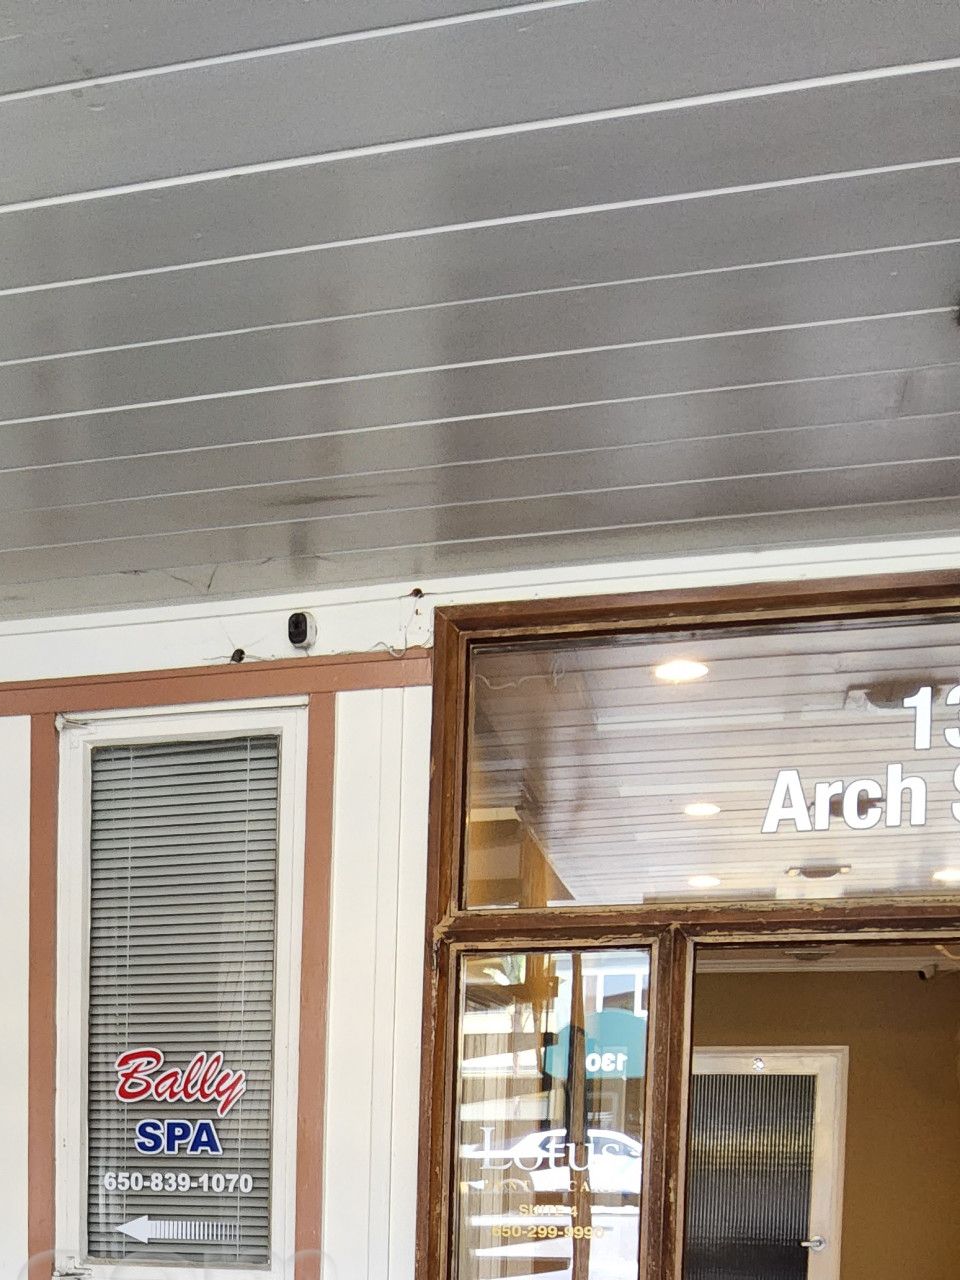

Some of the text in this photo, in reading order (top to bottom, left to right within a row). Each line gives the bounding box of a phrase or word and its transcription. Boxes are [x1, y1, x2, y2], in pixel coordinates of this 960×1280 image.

[761, 763, 928, 834] Arch
[115, 1047, 247, 1118] Bally
[135, 1119, 223, 1155] SPA
[103, 1171, 253, 1193] 650-839-1070
